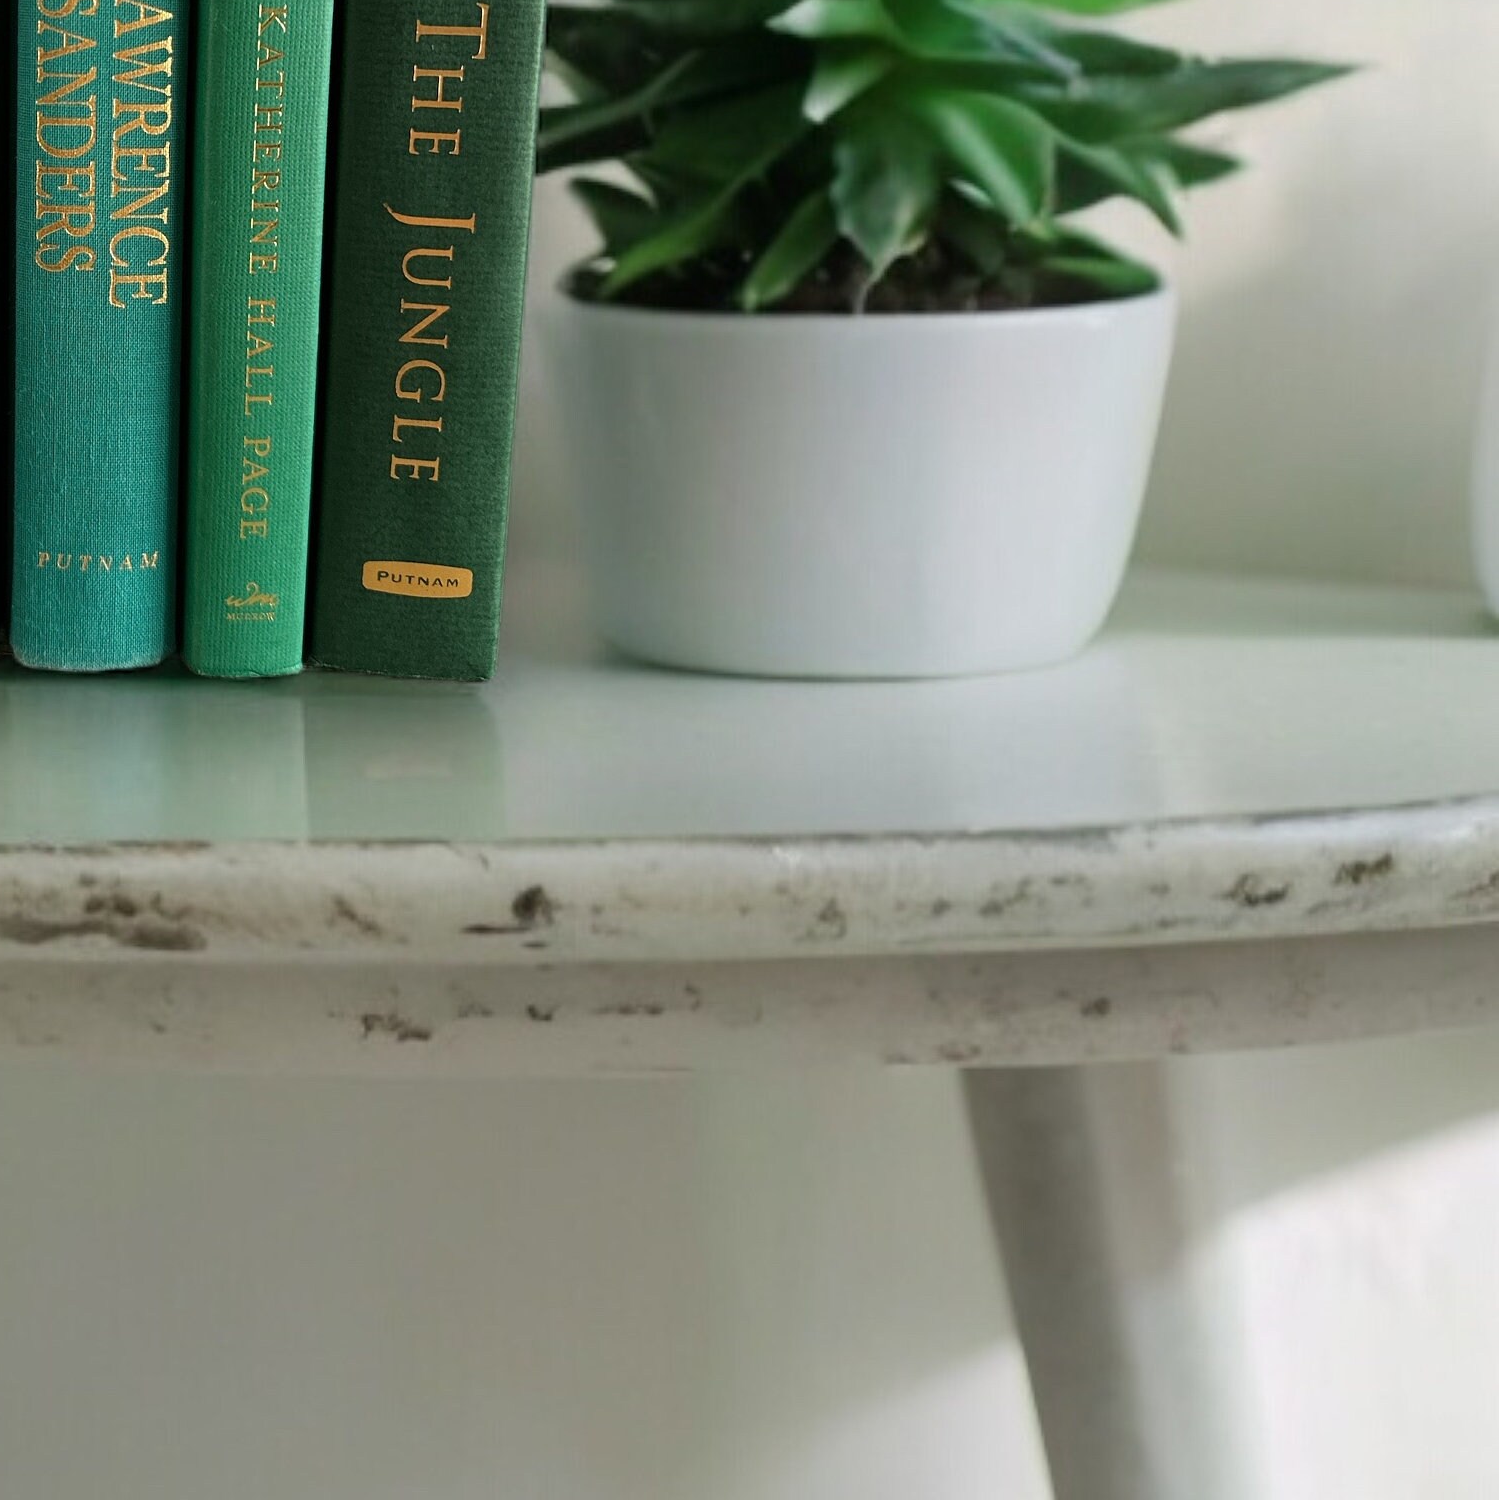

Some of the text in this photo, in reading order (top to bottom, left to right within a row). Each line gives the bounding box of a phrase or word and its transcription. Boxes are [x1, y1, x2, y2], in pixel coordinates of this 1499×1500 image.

[239, 3, 289, 540] KATHERINE HALL PAGE
[383, 3, 490, 483] THE JUNGLE
[37, 550, 159, 571] PUTNAM
[377, 570, 459, 588] PUTNAM
